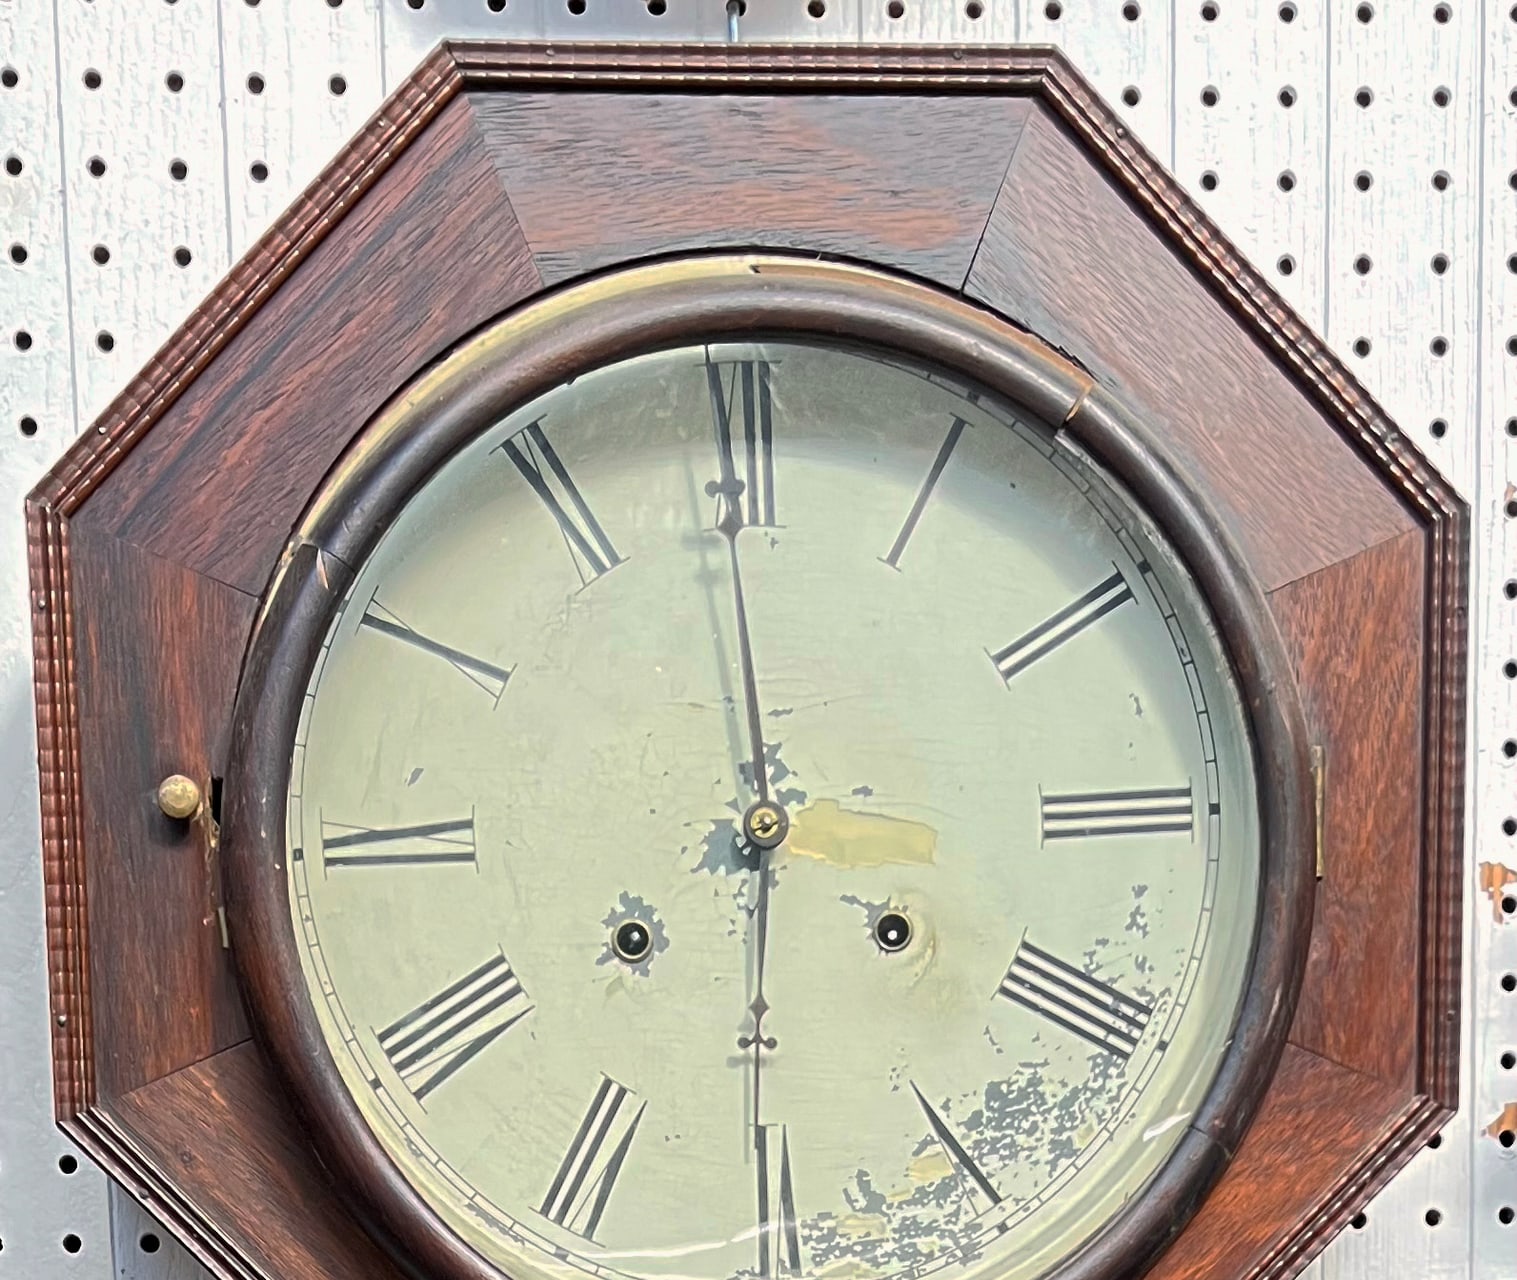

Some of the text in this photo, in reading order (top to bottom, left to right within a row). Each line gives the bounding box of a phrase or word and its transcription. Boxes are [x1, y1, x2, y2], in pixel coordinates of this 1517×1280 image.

[489, 414, 631, 595] XI
[694, 360, 788, 531] XII
[876, 412, 975, 572] I
[355, 586, 518, 711] X
[983, 560, 1139, 691] II
[319, 804, 480, 881] IX
[1038, 776, 1194, 850] III
[369, 943, 536, 1115] VIII
[528, 1070, 648, 1248] VII
